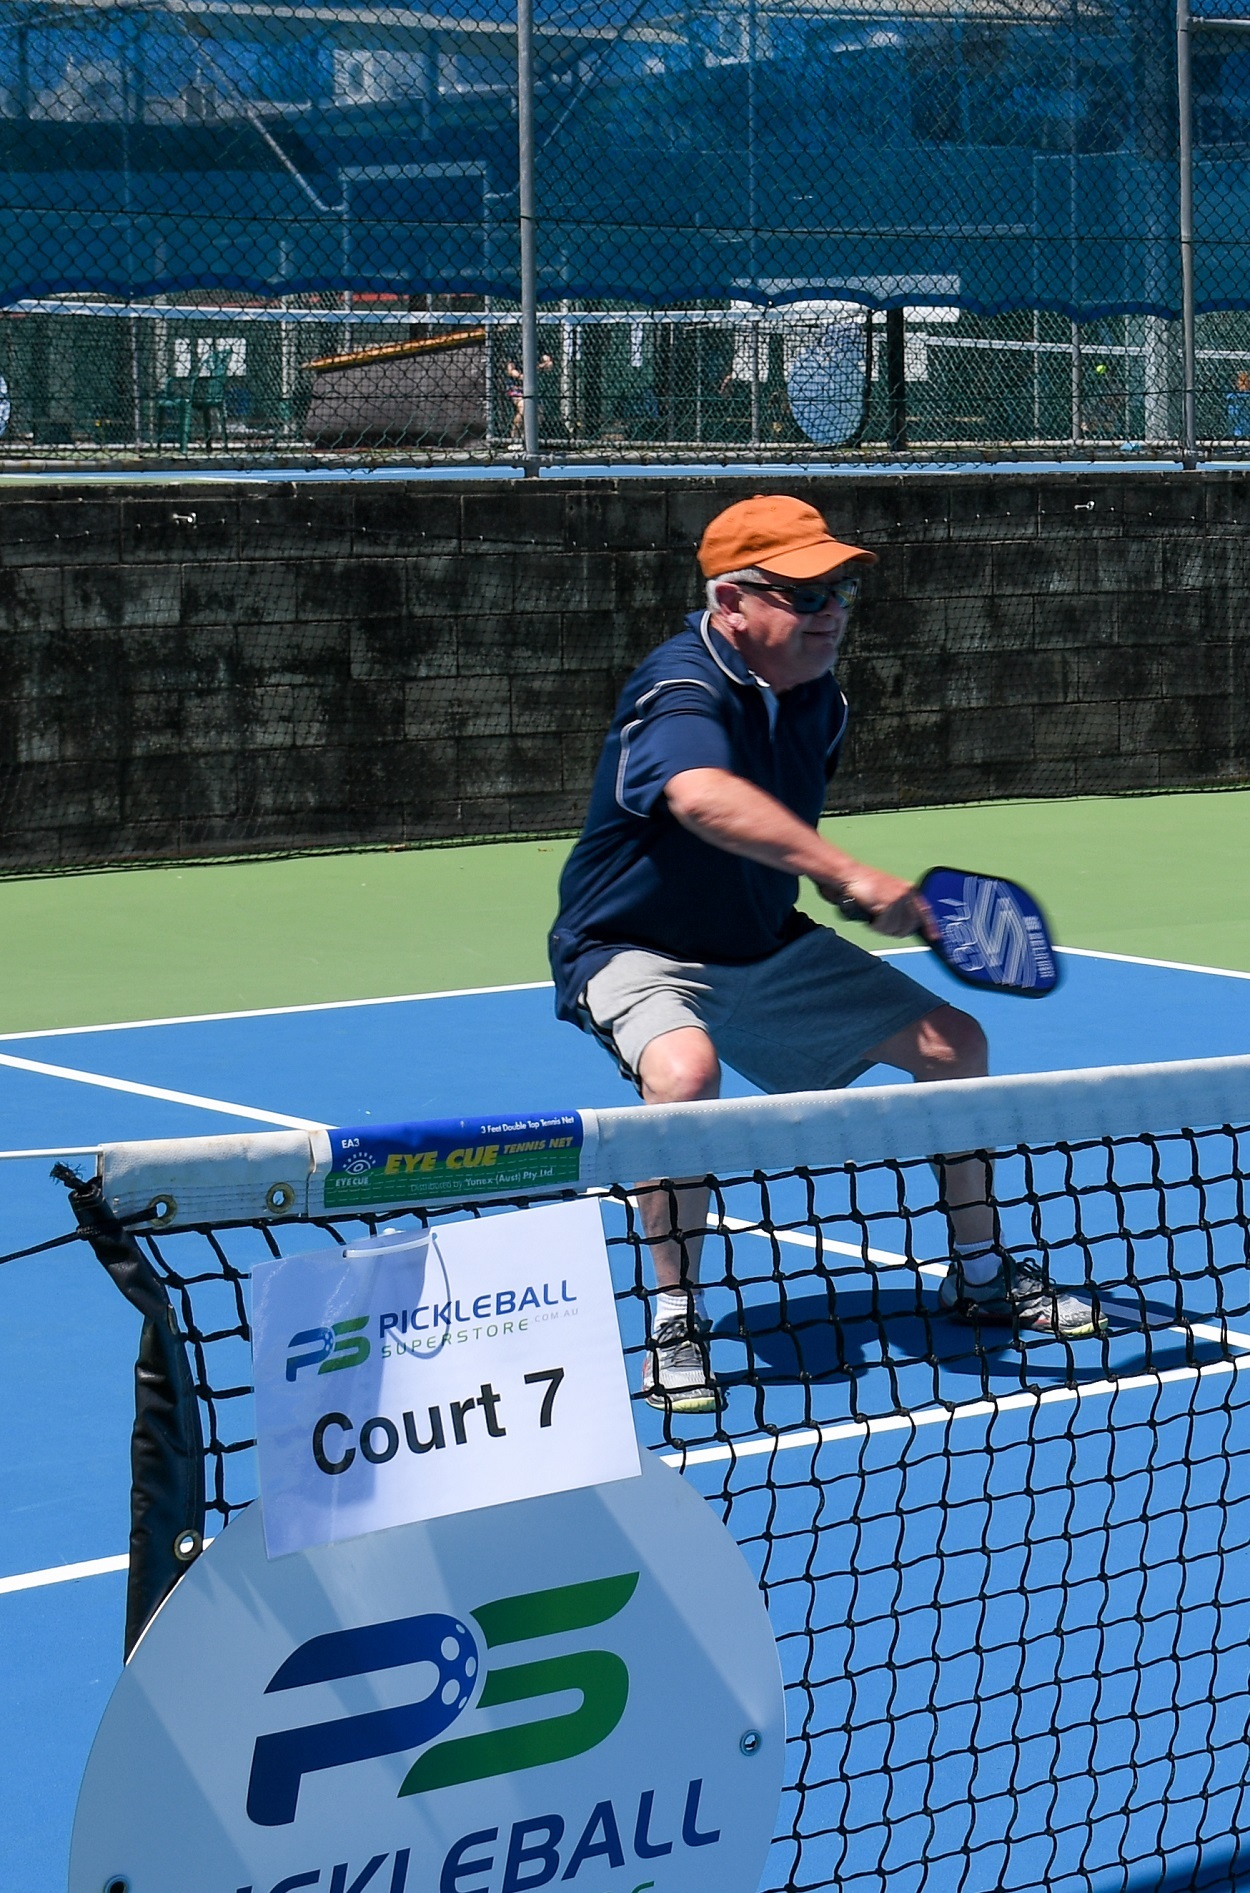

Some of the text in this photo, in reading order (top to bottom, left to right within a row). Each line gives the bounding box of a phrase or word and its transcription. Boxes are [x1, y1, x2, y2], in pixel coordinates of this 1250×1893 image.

[341, 1137, 360, 1149] EA3
[480, 1115, 575, 1134] 3 Feet Double Top Tennis Net
[384, 1136, 574, 1175] EYE CUE TENNIS NET
[410, 1180, 452, 1192] Distributed
[453, 1179, 463, 1190] by
[496, 1173, 521, 1185] (Aust)
[523, 1171, 538, 1181] Pty
[540, 1167, 553, 1177] Ltd
[379, 1279, 578, 1339] PICKLEBALL
[381, 1318, 529, 1360] SUPERSTORE
[312, 1366, 566, 1476] Court 7
